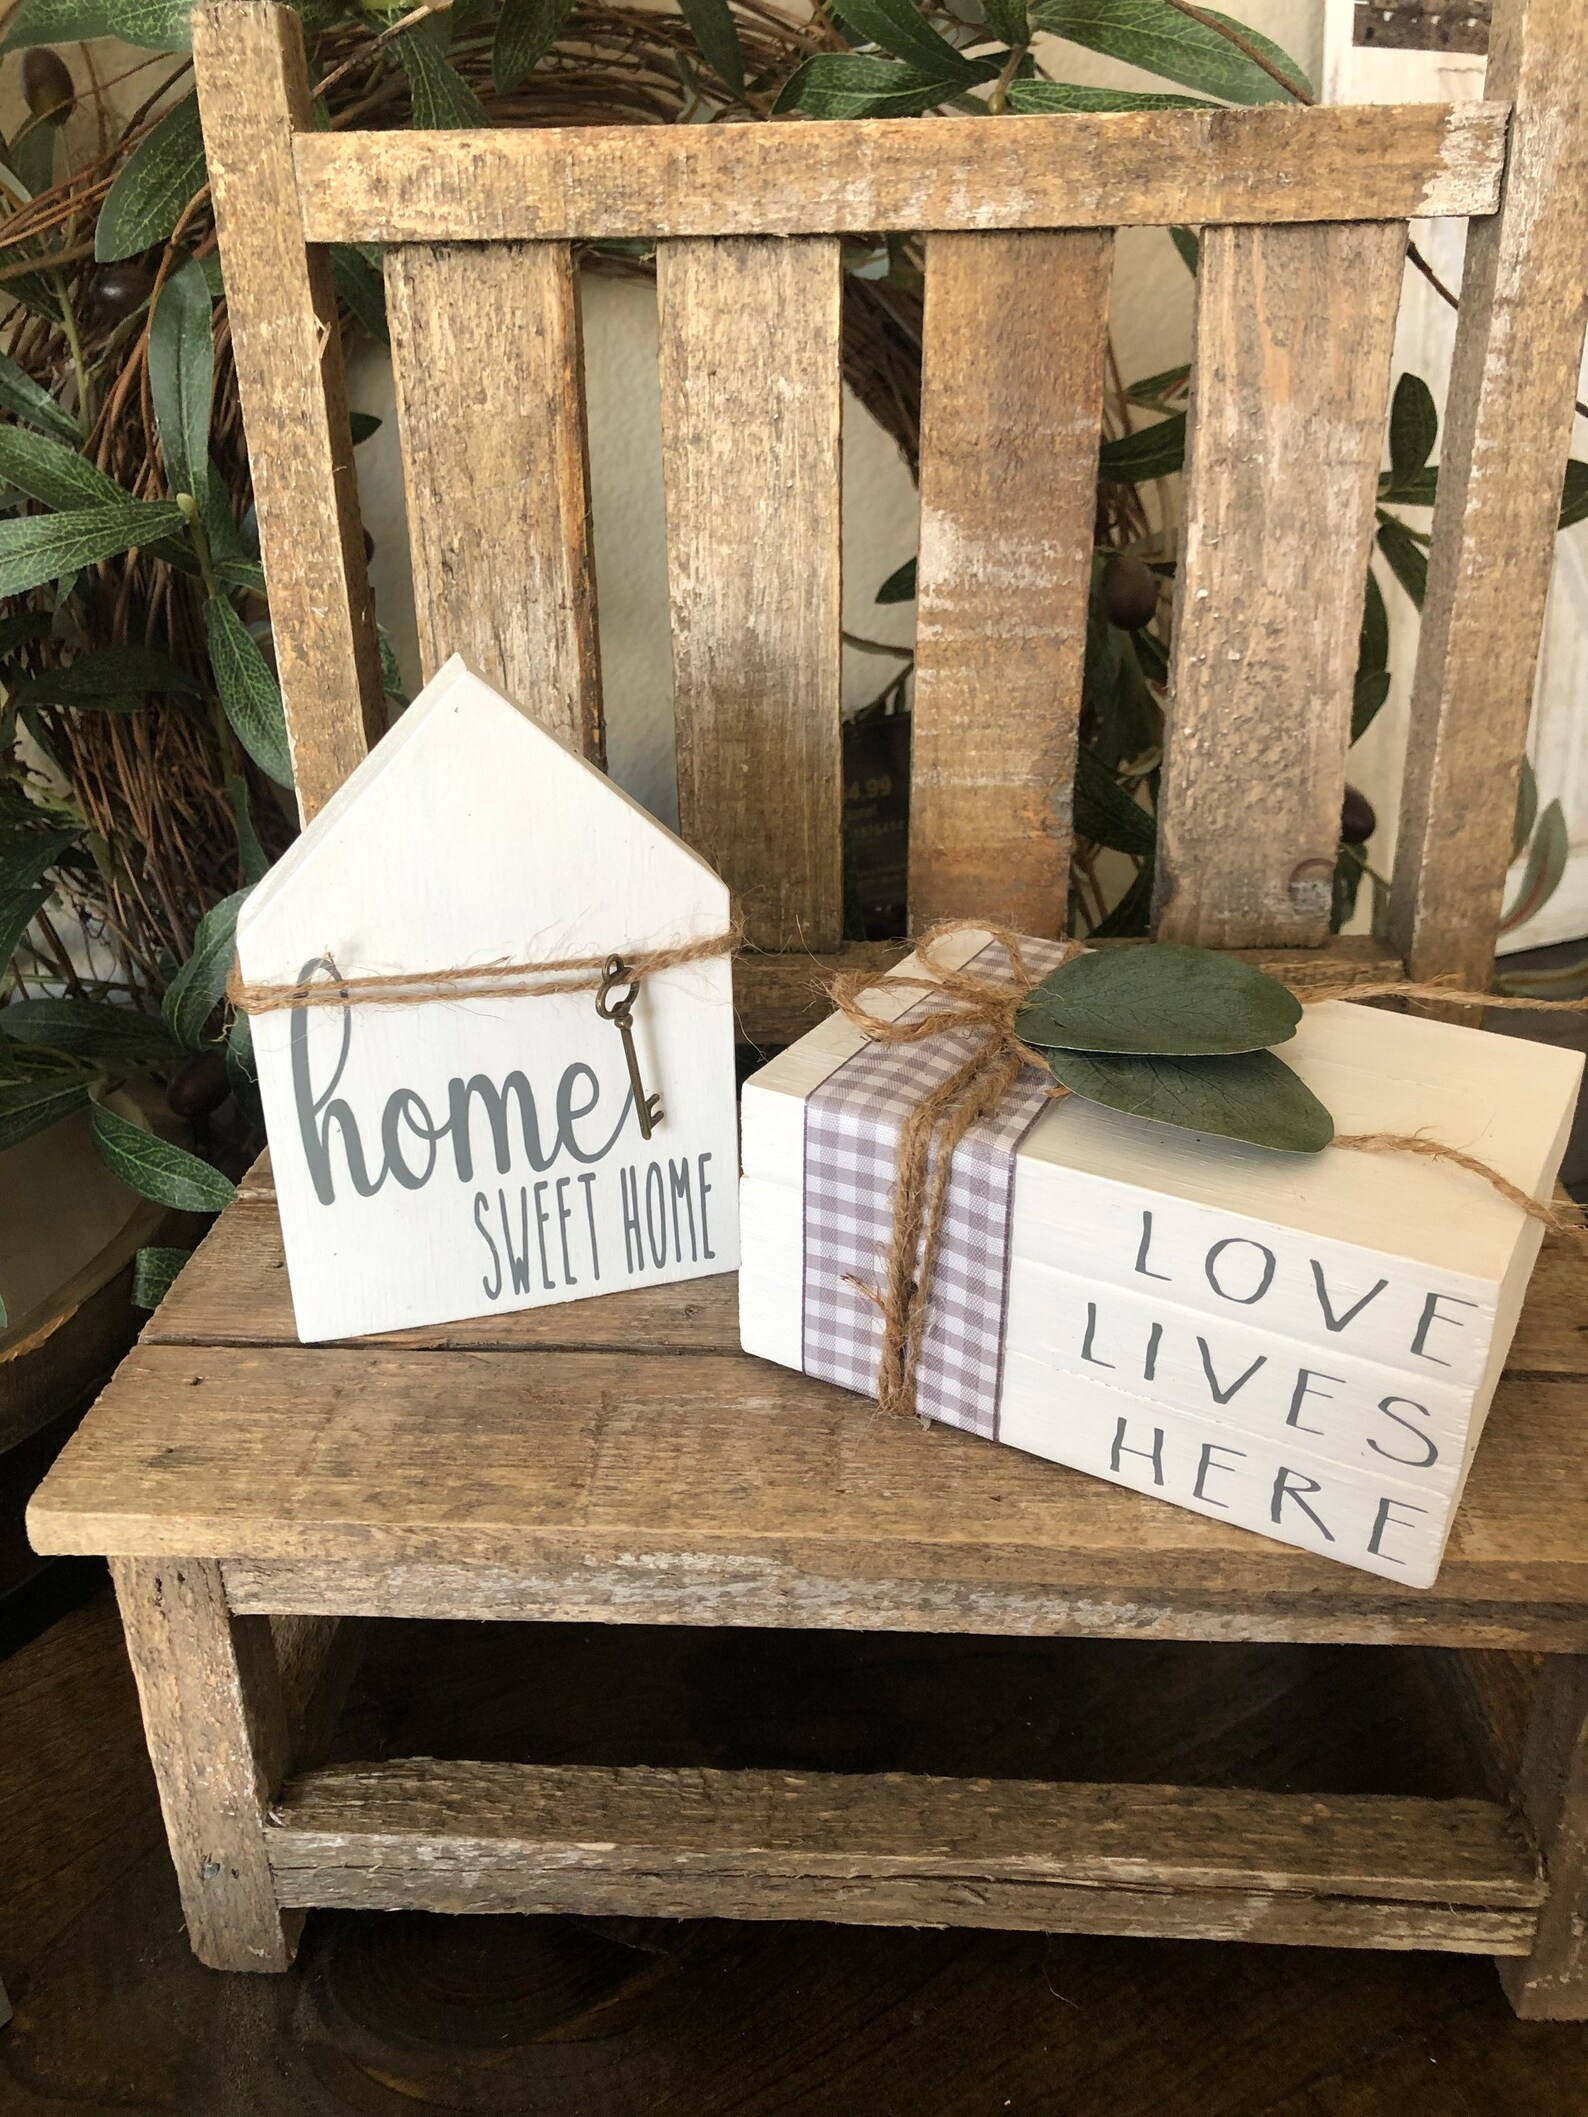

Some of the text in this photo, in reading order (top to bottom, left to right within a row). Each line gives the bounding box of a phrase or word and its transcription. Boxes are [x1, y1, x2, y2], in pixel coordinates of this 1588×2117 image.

[291, 957, 635, 1205] home
[474, 1152, 716, 1300] SWEET HOME
[1135, 1210, 1479, 1367] LOVE
[1081, 1302, 1438, 1468] LIVES
[1110, 1416, 1429, 1565] HERE
